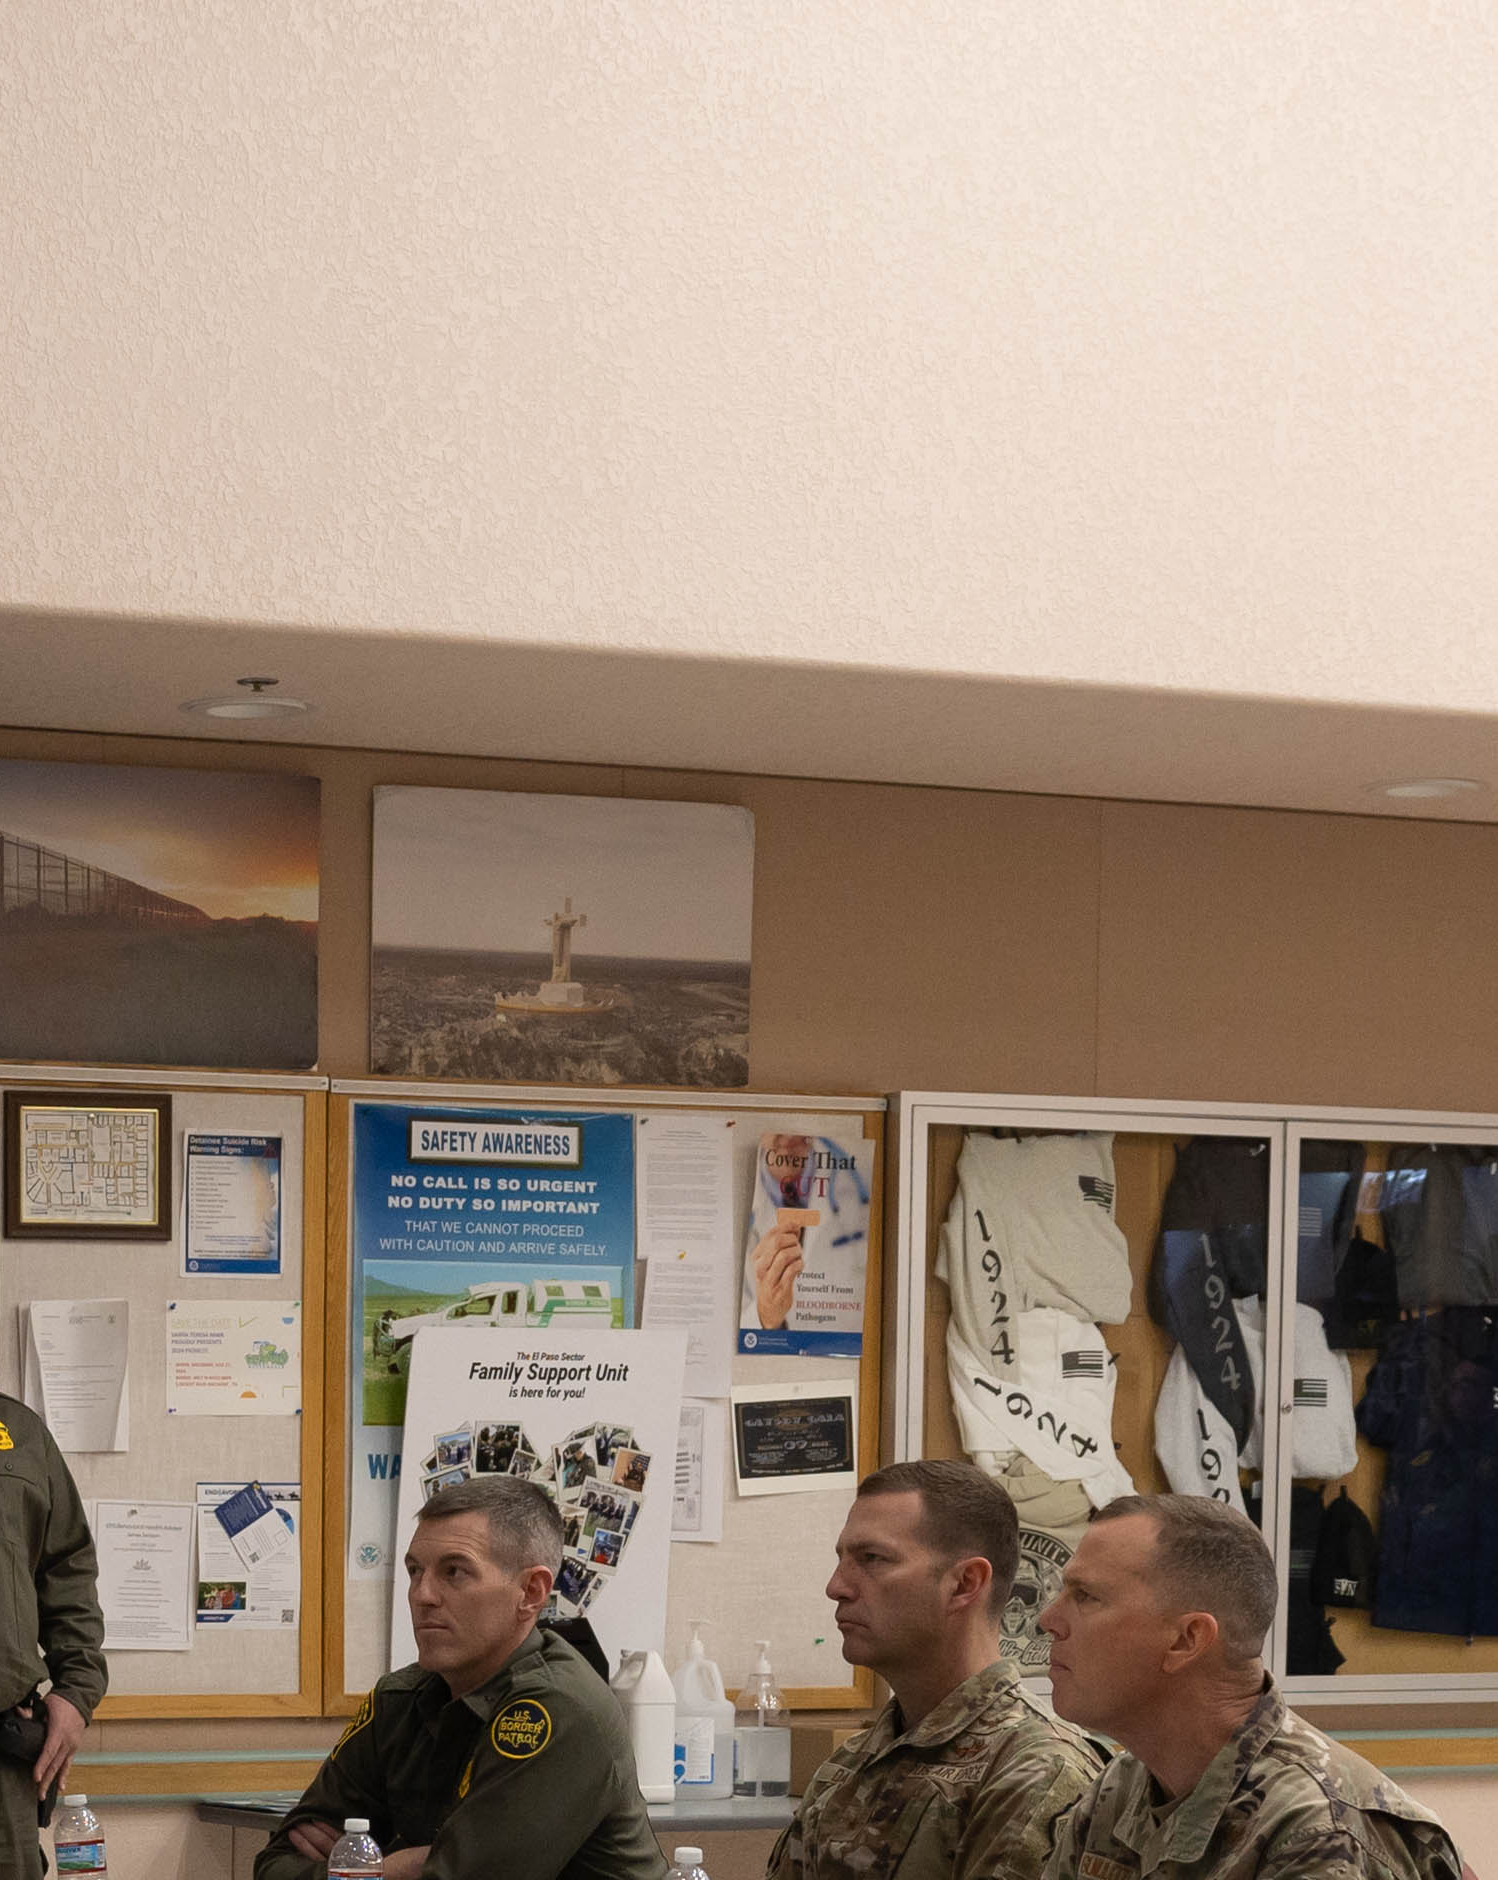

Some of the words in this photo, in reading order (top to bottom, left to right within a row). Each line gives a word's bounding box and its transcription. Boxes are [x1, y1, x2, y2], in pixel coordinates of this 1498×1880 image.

[421, 1129, 478, 1153] SAFETY
[482, 1132, 570, 1156] AWARENESS
[765, 1149, 809, 1169] Cover
[812, 1151, 856, 1171] That
[390, 1175, 416, 1188] NO
[423, 1176, 467, 1189] CALL
[474, 1177, 491, 1190] IS
[497, 1178, 521, 1191] SO
[527, 1179, 597, 1193] URGENT
[780, 1176, 830, 1197] CUT
[387, 1196, 412, 1208] NO
[419, 1196, 467, 1210] DUTY
[472, 1198, 495, 1211] SO
[502, 1199, 600, 1214] IMPORTANT
[405, 1220, 437, 1233] THAT
[440, 1221, 461, 1233] WE
[465, 1222, 519, 1235] CANNOT
[522, 1223, 584, 1237] PROCEED
[379, 1238, 412, 1251] WITH
[419, 1239, 474, 1252] CAUTION
[479, 1241, 504, 1253] AND
[508, 1242, 555, 1255] ARRIVE
[558, 1244, 608, 1257] SAFELY.
[797, 1270, 826, 1280] Protect
[796, 1284, 829, 1294] Yourself
[831, 1285, 854, 1294] From
[974, 1209, 1015, 1366] 1924
[796, 1301, 862, 1311] BLOODBORNE
[1199, 1232, 1242, 1391] 1924
[795, 1312, 836, 1323] Pathogens
[517, 1352, 531, 1361] The
[532, 1352, 540, 1361] El
[541, 1353, 559, 1361] Paso
[561, 1352, 586, 1361] Sector
[469, 1362, 523, 1385] Family
[527, 1363, 592, 1385] Support
[596, 1364, 629, 1381] Unit
[508, 1386, 518, 1398] is
[520, 1386, 544, 1398] here
[546, 1386, 561, 1398] for
[563, 1387, 586, 1401] you!
[973, 1377, 1099, 1458] 1924
[1021, 1533, 1065, 1560] UNIT
[514, 1710, 531, 1721] U.S.
[500, 1721, 541, 1734] BORDER
[499, 1732, 539, 1745] PATROL
